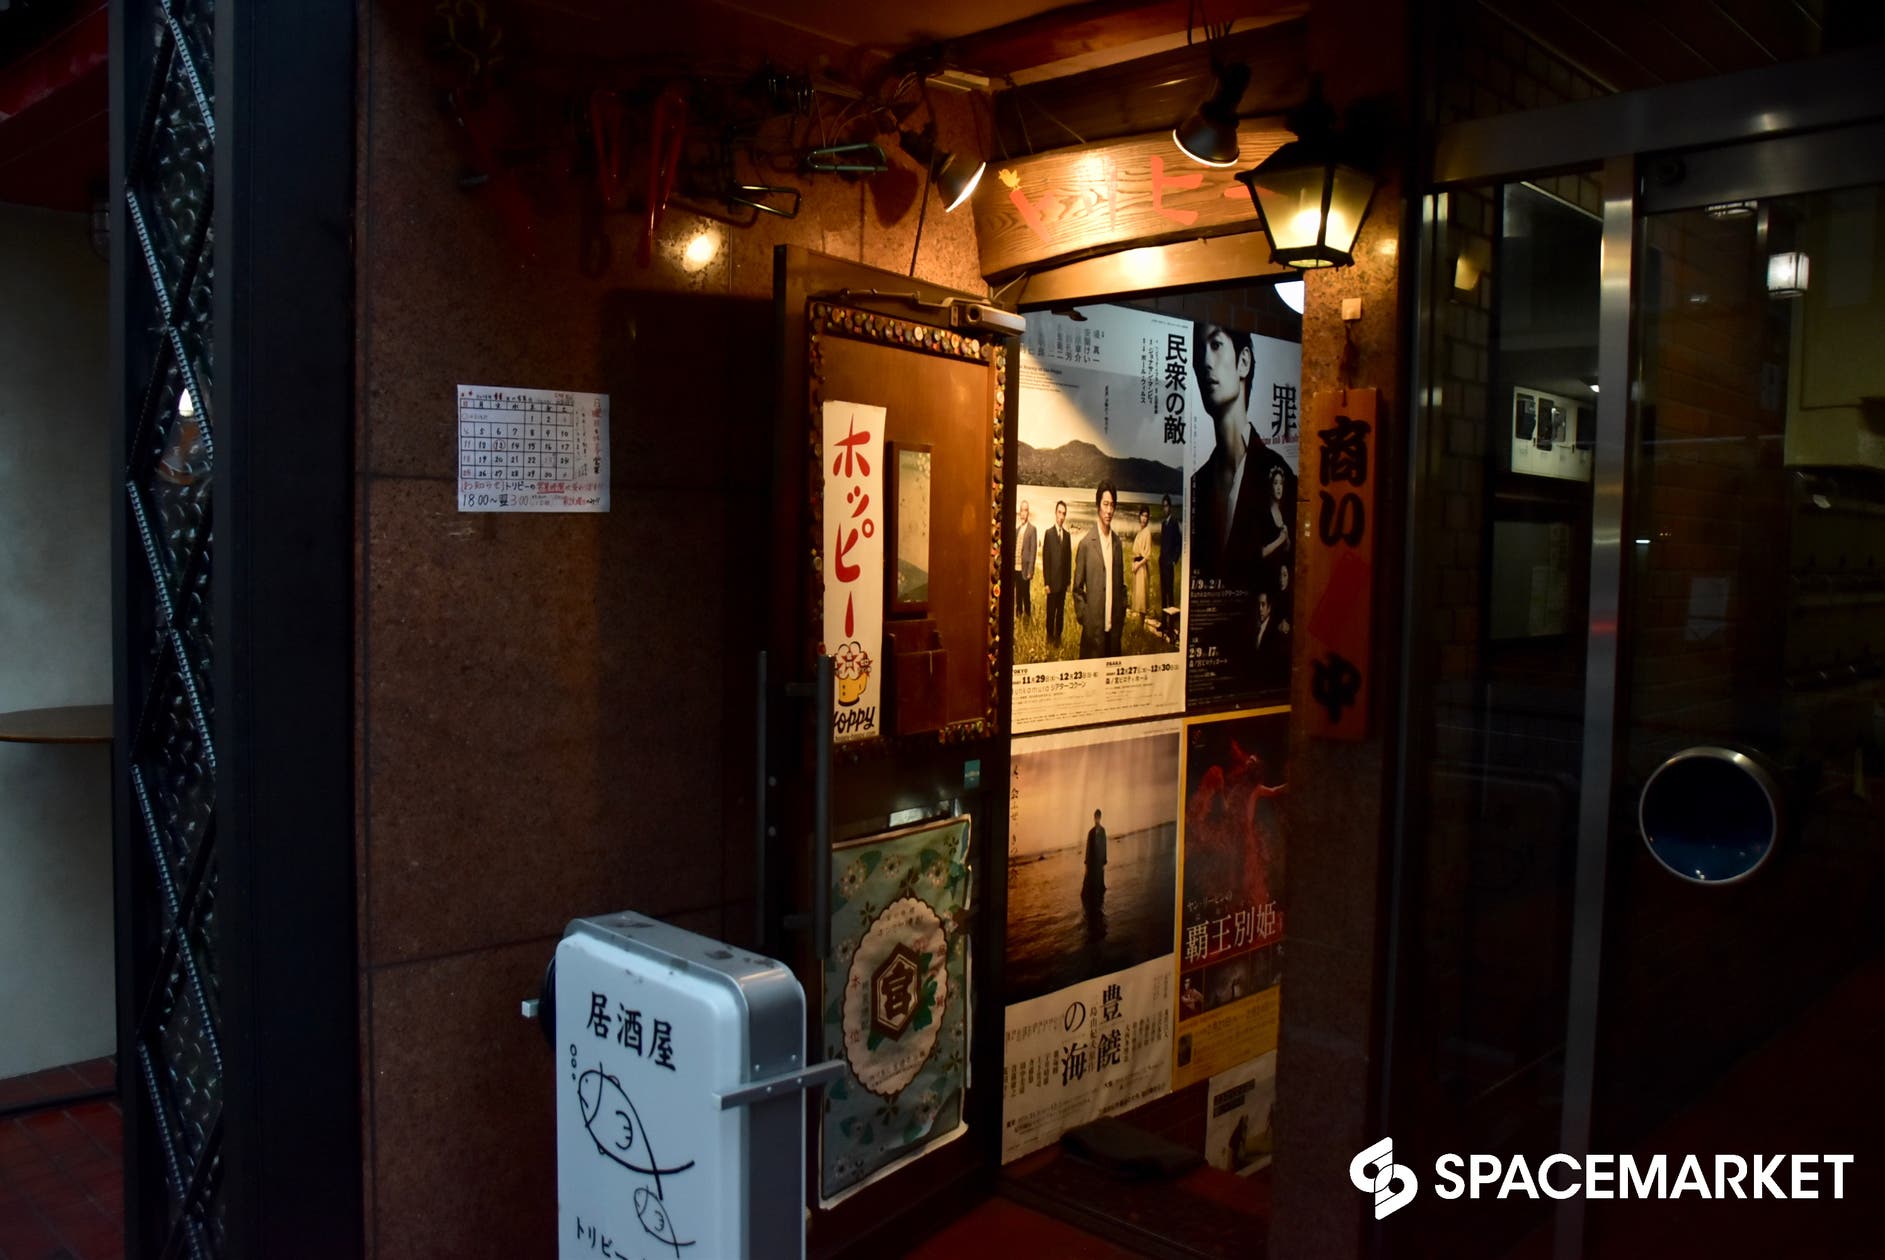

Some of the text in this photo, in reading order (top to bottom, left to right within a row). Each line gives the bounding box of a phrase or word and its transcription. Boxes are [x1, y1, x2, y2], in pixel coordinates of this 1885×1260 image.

[1164, 333, 1188, 444] 民衆の敵
[1272, 383, 1297, 438] 罪
[833, 412, 875, 638] ホッピー
[1311, 414, 1371, 726] 商い中
[1184, 901, 1277, 964] 覇王別姫
[882, 961, 913, 1019] 宮
[586, 991, 677, 1072] 居酒屋
